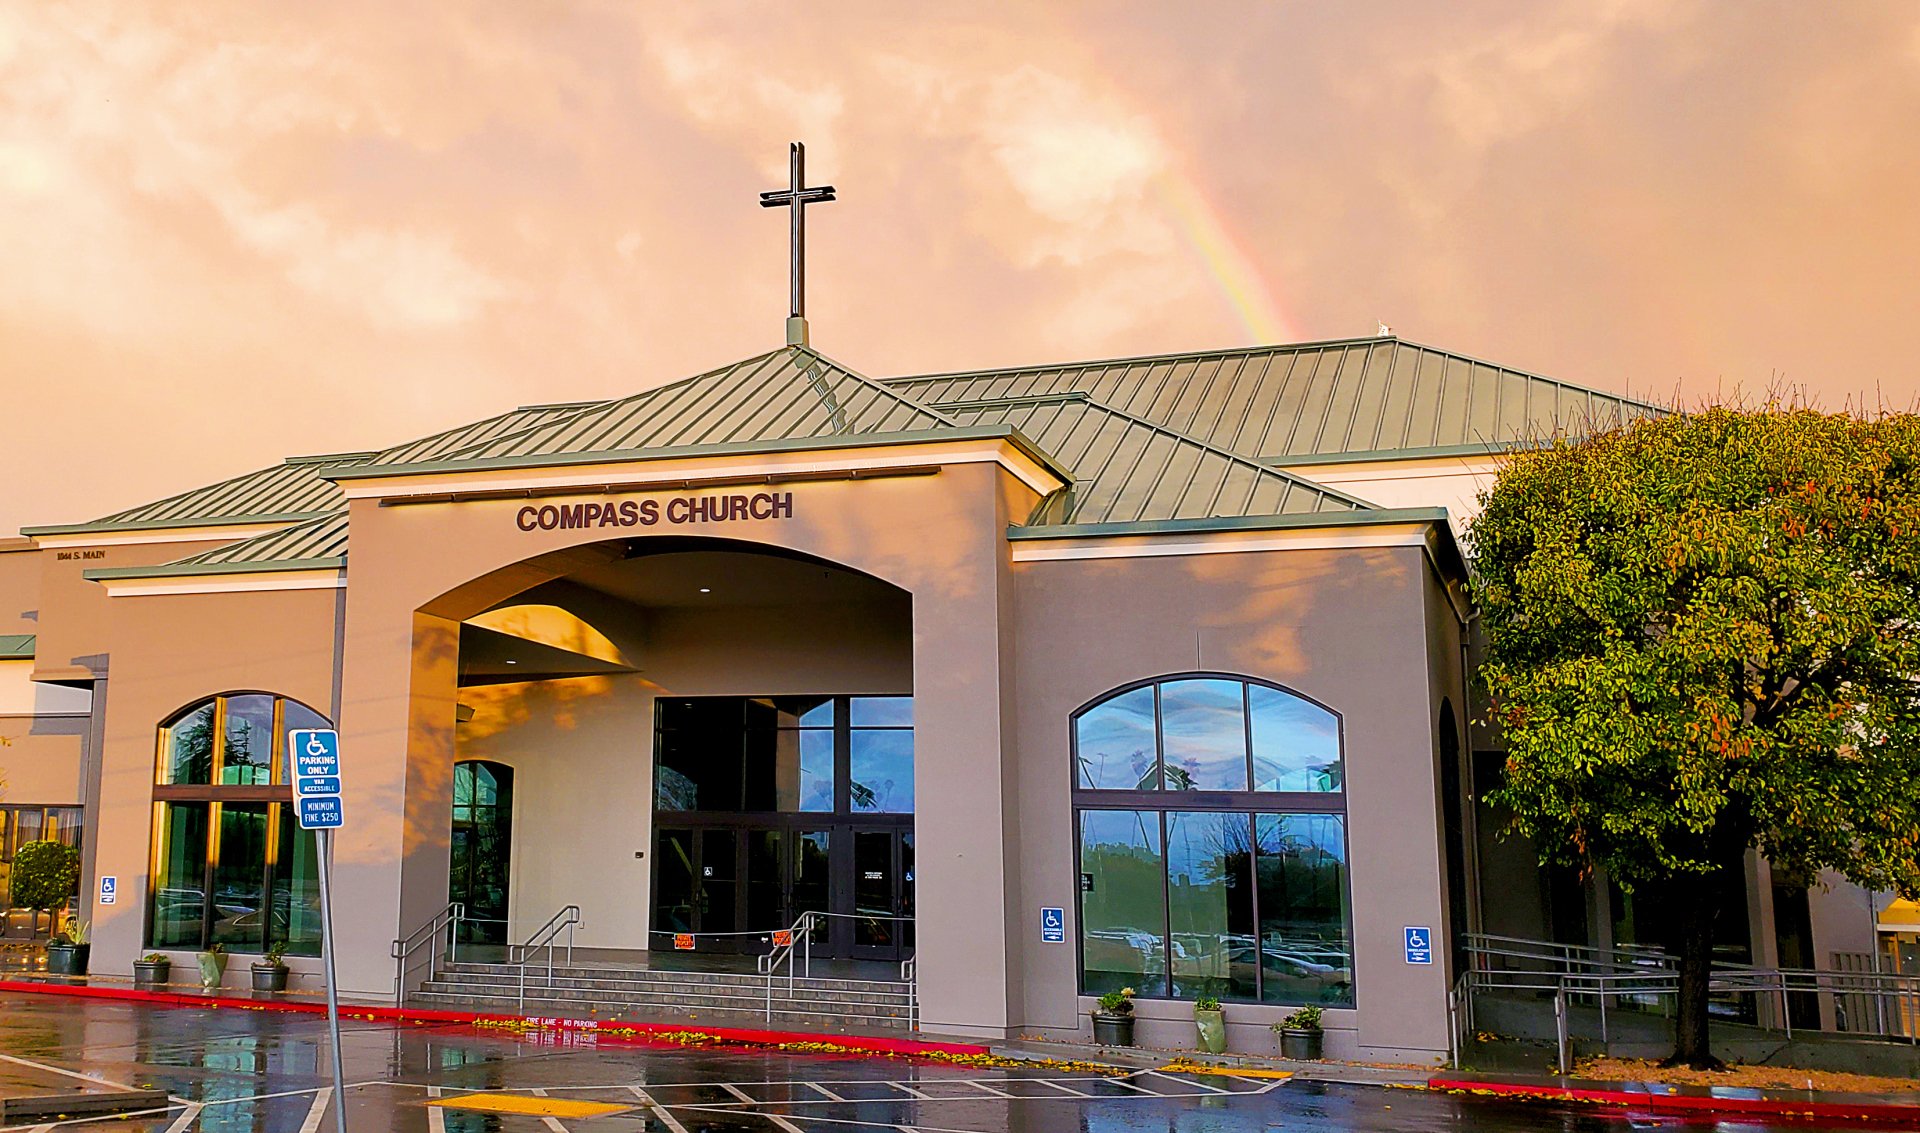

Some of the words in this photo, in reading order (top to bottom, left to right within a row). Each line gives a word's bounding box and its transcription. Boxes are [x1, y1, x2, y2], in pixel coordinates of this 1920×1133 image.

[516, 499, 660, 531] COMPASS
[667, 492, 793, 524] CHURCH
[83, 550, 106, 559] MAIN
[299, 756, 336, 765] PARKING
[307, 766, 329, 775] ONLY
[307, 802, 335, 811] MINIMUM
[304, 813, 319, 822] FINE
[321, 812, 339, 822] $250
[541, 1018, 557, 1026] LANE
[563, 1019, 572, 1027] NO
[573, 1020, 598, 1028] PARKING
